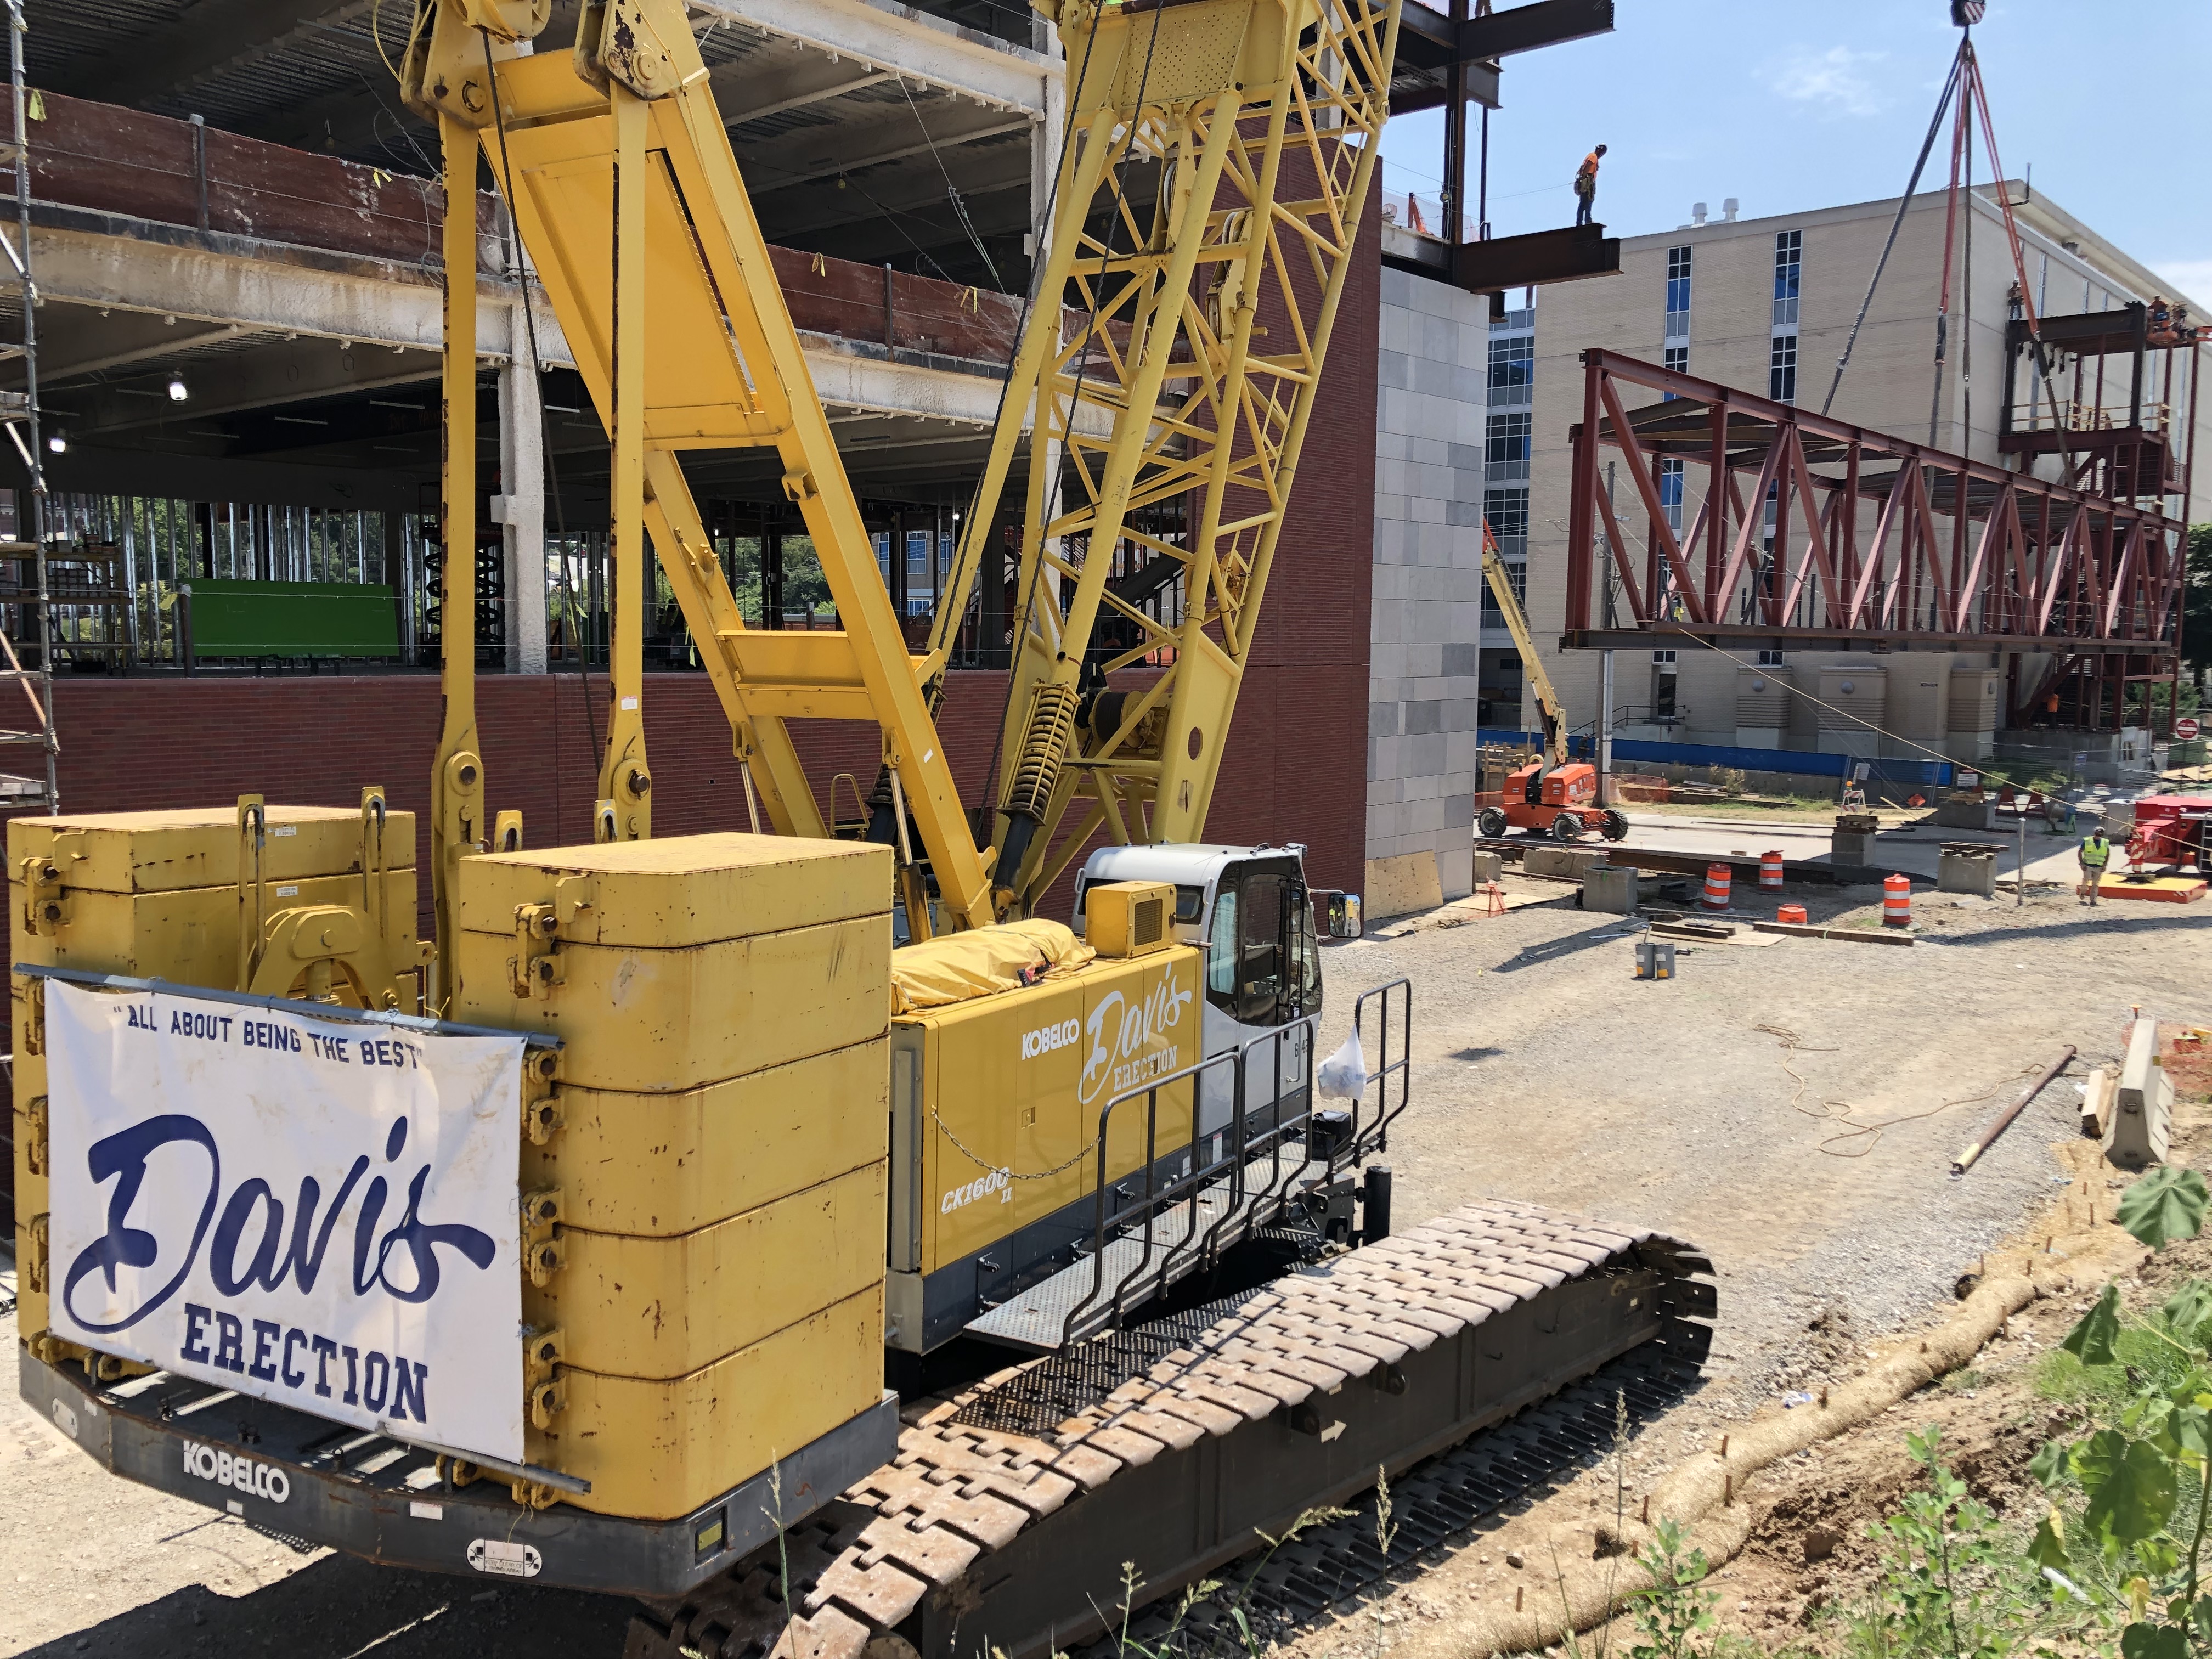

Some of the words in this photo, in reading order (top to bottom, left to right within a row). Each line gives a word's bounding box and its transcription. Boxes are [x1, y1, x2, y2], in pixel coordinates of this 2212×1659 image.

[171, 1010, 233, 1042] ABOUT
[244, 1020, 301, 1052] BEING
[307, 1032, 350, 1063] THE
[1022, 1018, 1080, 1060] KOBELCO
[1077, 961, 1192, 1105] Davis
[1113, 1045, 1178, 1092] ERECTION
[941, 1166, 1010, 1215] CK1600
[63, 1115, 496, 1334] Davis
[180, 1302, 428, 1424] ERECTION
[183, 1438, 290, 1504] KOBELCO
